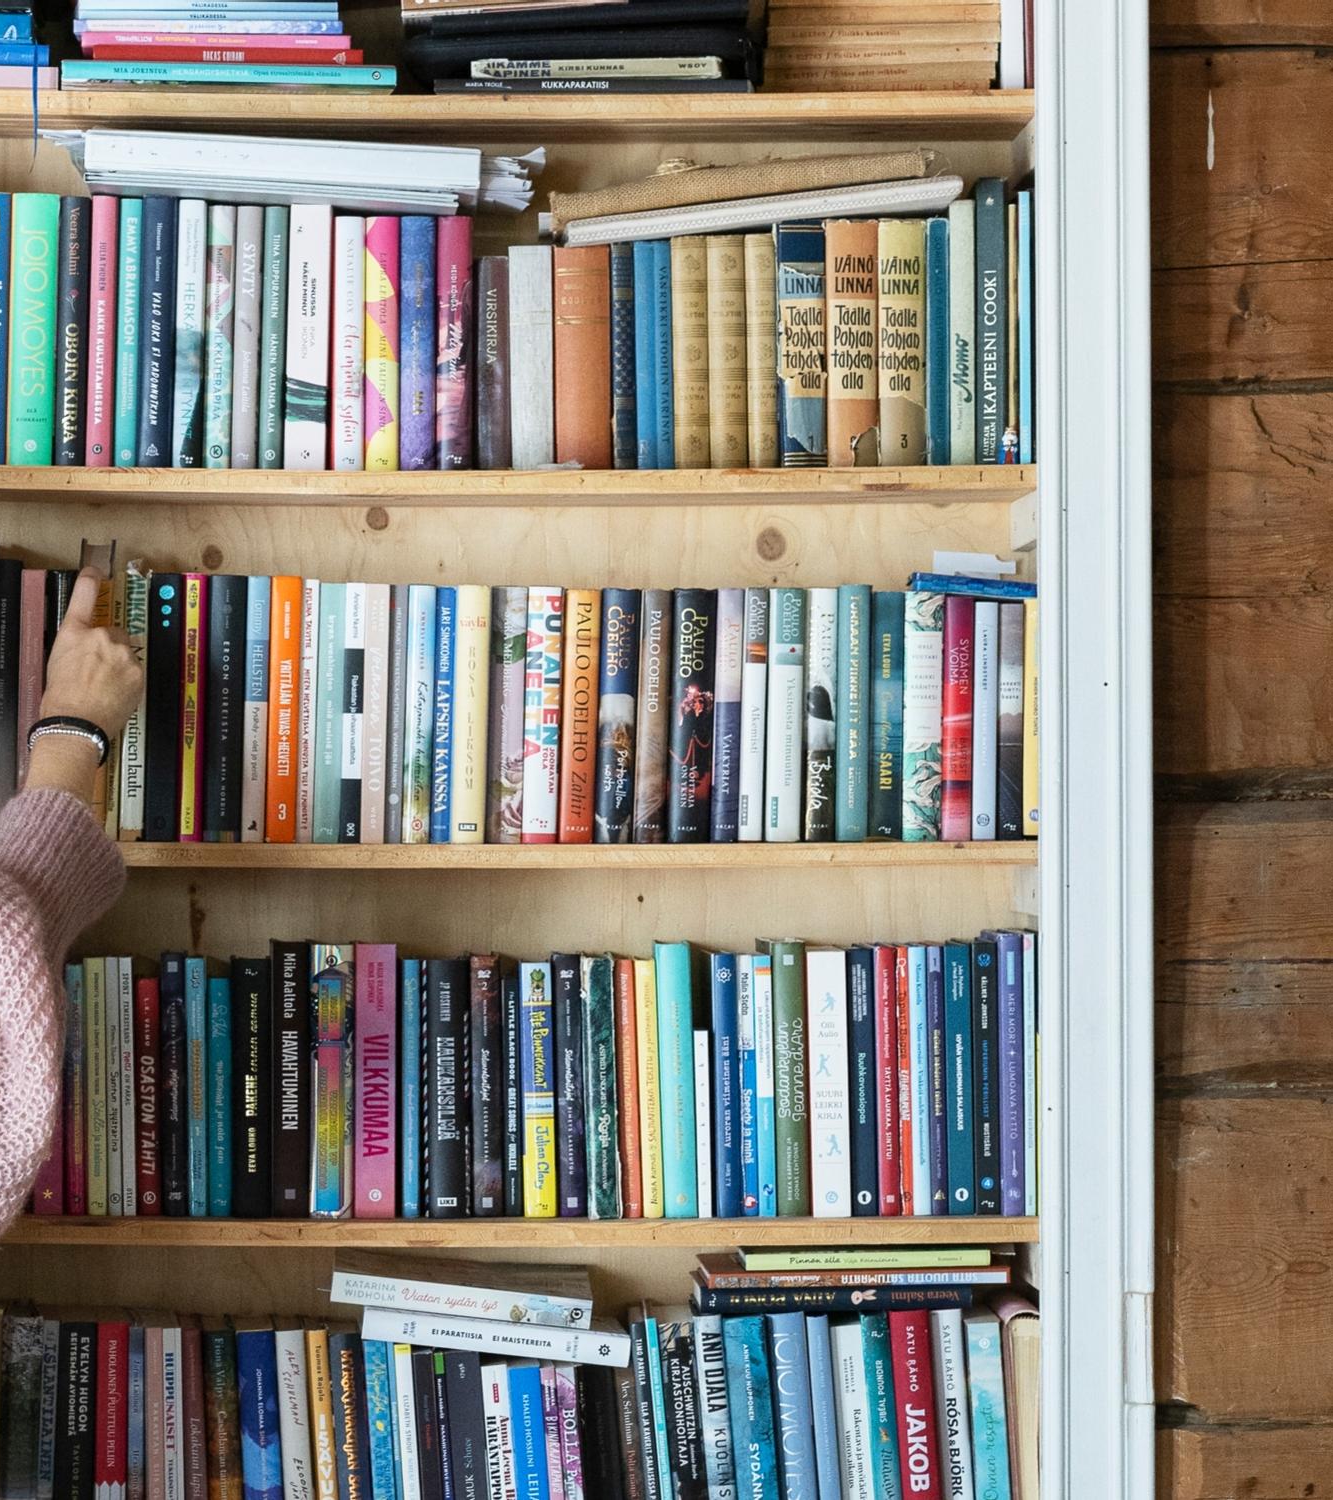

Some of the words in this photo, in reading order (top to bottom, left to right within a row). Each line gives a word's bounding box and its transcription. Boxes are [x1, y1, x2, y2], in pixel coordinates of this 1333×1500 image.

[541, 81, 609, 89] KUKKAPARATIISI
[69, 207, 80, 239] Veera
[126, 217, 138, 253] EMMY
[19, 227, 48, 292] JOJO
[69, 242, 79, 276] Salmi
[271, 235, 280, 256] TIINA
[834, 256, 873, 274] VÄINÖ
[882, 256, 919, 275] VÄINÖ
[123, 256, 137, 345] ABRAHAMSON
[270, 259, 280, 318] TUPPURAINEN
[786, 278, 822, 294] LINNA
[835, 278, 873, 293] LINNA
[882, 279, 919, 295] LINNA
[984, 277, 996, 325] COOK
[486, 289, 496, 364] VIRSIKIRJA
[835, 305, 870, 325] Täällä
[882, 307, 917, 327] Täällä
[20, 299, 47, 396] MOYES
[63, 323, 79, 381] OBOIN
[269, 334, 278, 363] HÄNEN
[834, 326, 873, 349] Pohjan
[882, 327, 919, 350] Pohjan
[832, 351, 873, 371] tähden
[984, 332, 996, 414] KAPTEENI
[268, 367, 276, 410] VALTANSA
[842, 373, 863, 389] alla
[889, 373, 910, 391] alla
[62, 387, 78, 443] KIRJA
[267, 413, 276, 433] ALLA
[901, 434, 907, 449] 3
[440, 607, 450, 625] JARI
[575, 601, 592, 670] PAULO
[650, 610, 661, 654] PAULO
[750, 597, 759, 640] COELHO
[758, 601, 766, 635] PAULO
[782, 593, 793, 641] COELHO
[791, 599, 801, 637] PAULO
[222, 641, 230, 680] EROON
[440, 627, 450, 672] SINKKONEN
[606, 606, 623, 676] COELHO
[679, 608, 696, 678] COELHO
[693, 615, 708, 671] PAULO
[279, 660, 294, 704] YRITTÄJÄN
[524, 595, 544, 759] PLANEETTA
[542, 595, 562, 746] PUNAINEN
[648, 657, 660, 712] COELHO
[949, 647, 959, 686] VOIMA
[959, 639, 971, 694] SYDÄMEN
[221, 688, 229, 741] OIREISTA
[434, 680, 451, 743] LAPSEN
[573, 675, 590, 762] COELHO
[750, 705, 761, 753] Alkemisti
[277, 709, 292, 776] TAIVAS+HELVETTI
[433, 748, 449, 813] KANSSA
[681, 765, 688, 780] ON
[721, 734, 732, 794] VALKYRIAT
[808, 756, 832, 810] Brida
[570, 771, 586, 818] Zahir
[680, 783, 688, 808] YKSIN
[284, 953, 295, 977] Mika
[283, 981, 295, 1018] Aaltola
[440, 990, 449, 1021] KOSKINEN
[722, 1036, 730, 1056] ääni
[1008, 1019, 1016, 1044] MORT
[140, 1056, 155, 1123] OSASTON
[281, 1031, 298, 1130] HAVAHTUMINEN
[362, 1034, 389, 1157] VILKKUMAA
[437, 1037, 460, 1141] HAUKANSILMÄ
[723, 1060, 731, 1106] viimeinen
[857, 1053, 867, 1124] Ruuhkavuosiopas
[535, 1126, 549, 1159] Julian
[598, 1114, 610, 1147] Ronja
[723, 1109, 732, 1147] Auroran
[1010, 1111, 1018, 1139] TYTTÖ
[142, 1131, 159, 1175] TÄHTI
[535, 1162, 549, 1190] Clary
[438, 1198, 457, 1206] LIKE
[344, 1289, 396, 1302] WIDHOLM
[345, 1279, 397, 1292] KATARINA
[891, 1291, 923, 1302] Salmi
[925, 1290, 960, 1302] Veera
[69, 1332, 79, 1381] SEITSEMÄN
[432, 1328, 439, 1336] EI
[440, 1329, 483, 1340] PARATIISIA
[502, 1336, 552, 1348] MAISTEREITA
[634, 1338, 643, 1356] TIMO
[906, 1326, 915, 1354] SATU
[80, 1337, 90, 1383] EVELYN
[108, 1340, 117, 1394] PAHOLAINEN
[636, 1358, 646, 1385] PARVELA
[906, 1359, 917, 1392] RÄMÖ
[67, 1384, 76, 1436] AVIOMIESTÄ
[79, 1388, 88, 1432] HUGON
[107, 1397, 116, 1437] PUUTTUU
[165, 1353, 175, 1450] HUIPPUNAISET
[522, 1394, 530, 1426] KHALED
[670, 1358, 688, 1467] KIRJASTONHOITAJA
[682, 1366, 696, 1440] AUSCHWITZIN
[746, 1381, 755, 1420] NUPPONEN
[107, 1440, 116, 1467] PELIIN
[189, 1417, 202, 1470] Lokakuun
[524, 1429, 534, 1468] HOSSEINI
[562, 1408, 578, 1463] BOLLA
[643, 1427, 652, 1454] KAVERIT
[905, 1404, 930, 1492] JAKOB
[191, 1473, 203, 1498] lapsi
[645, 1455, 655, 1492] SALAISESSA
